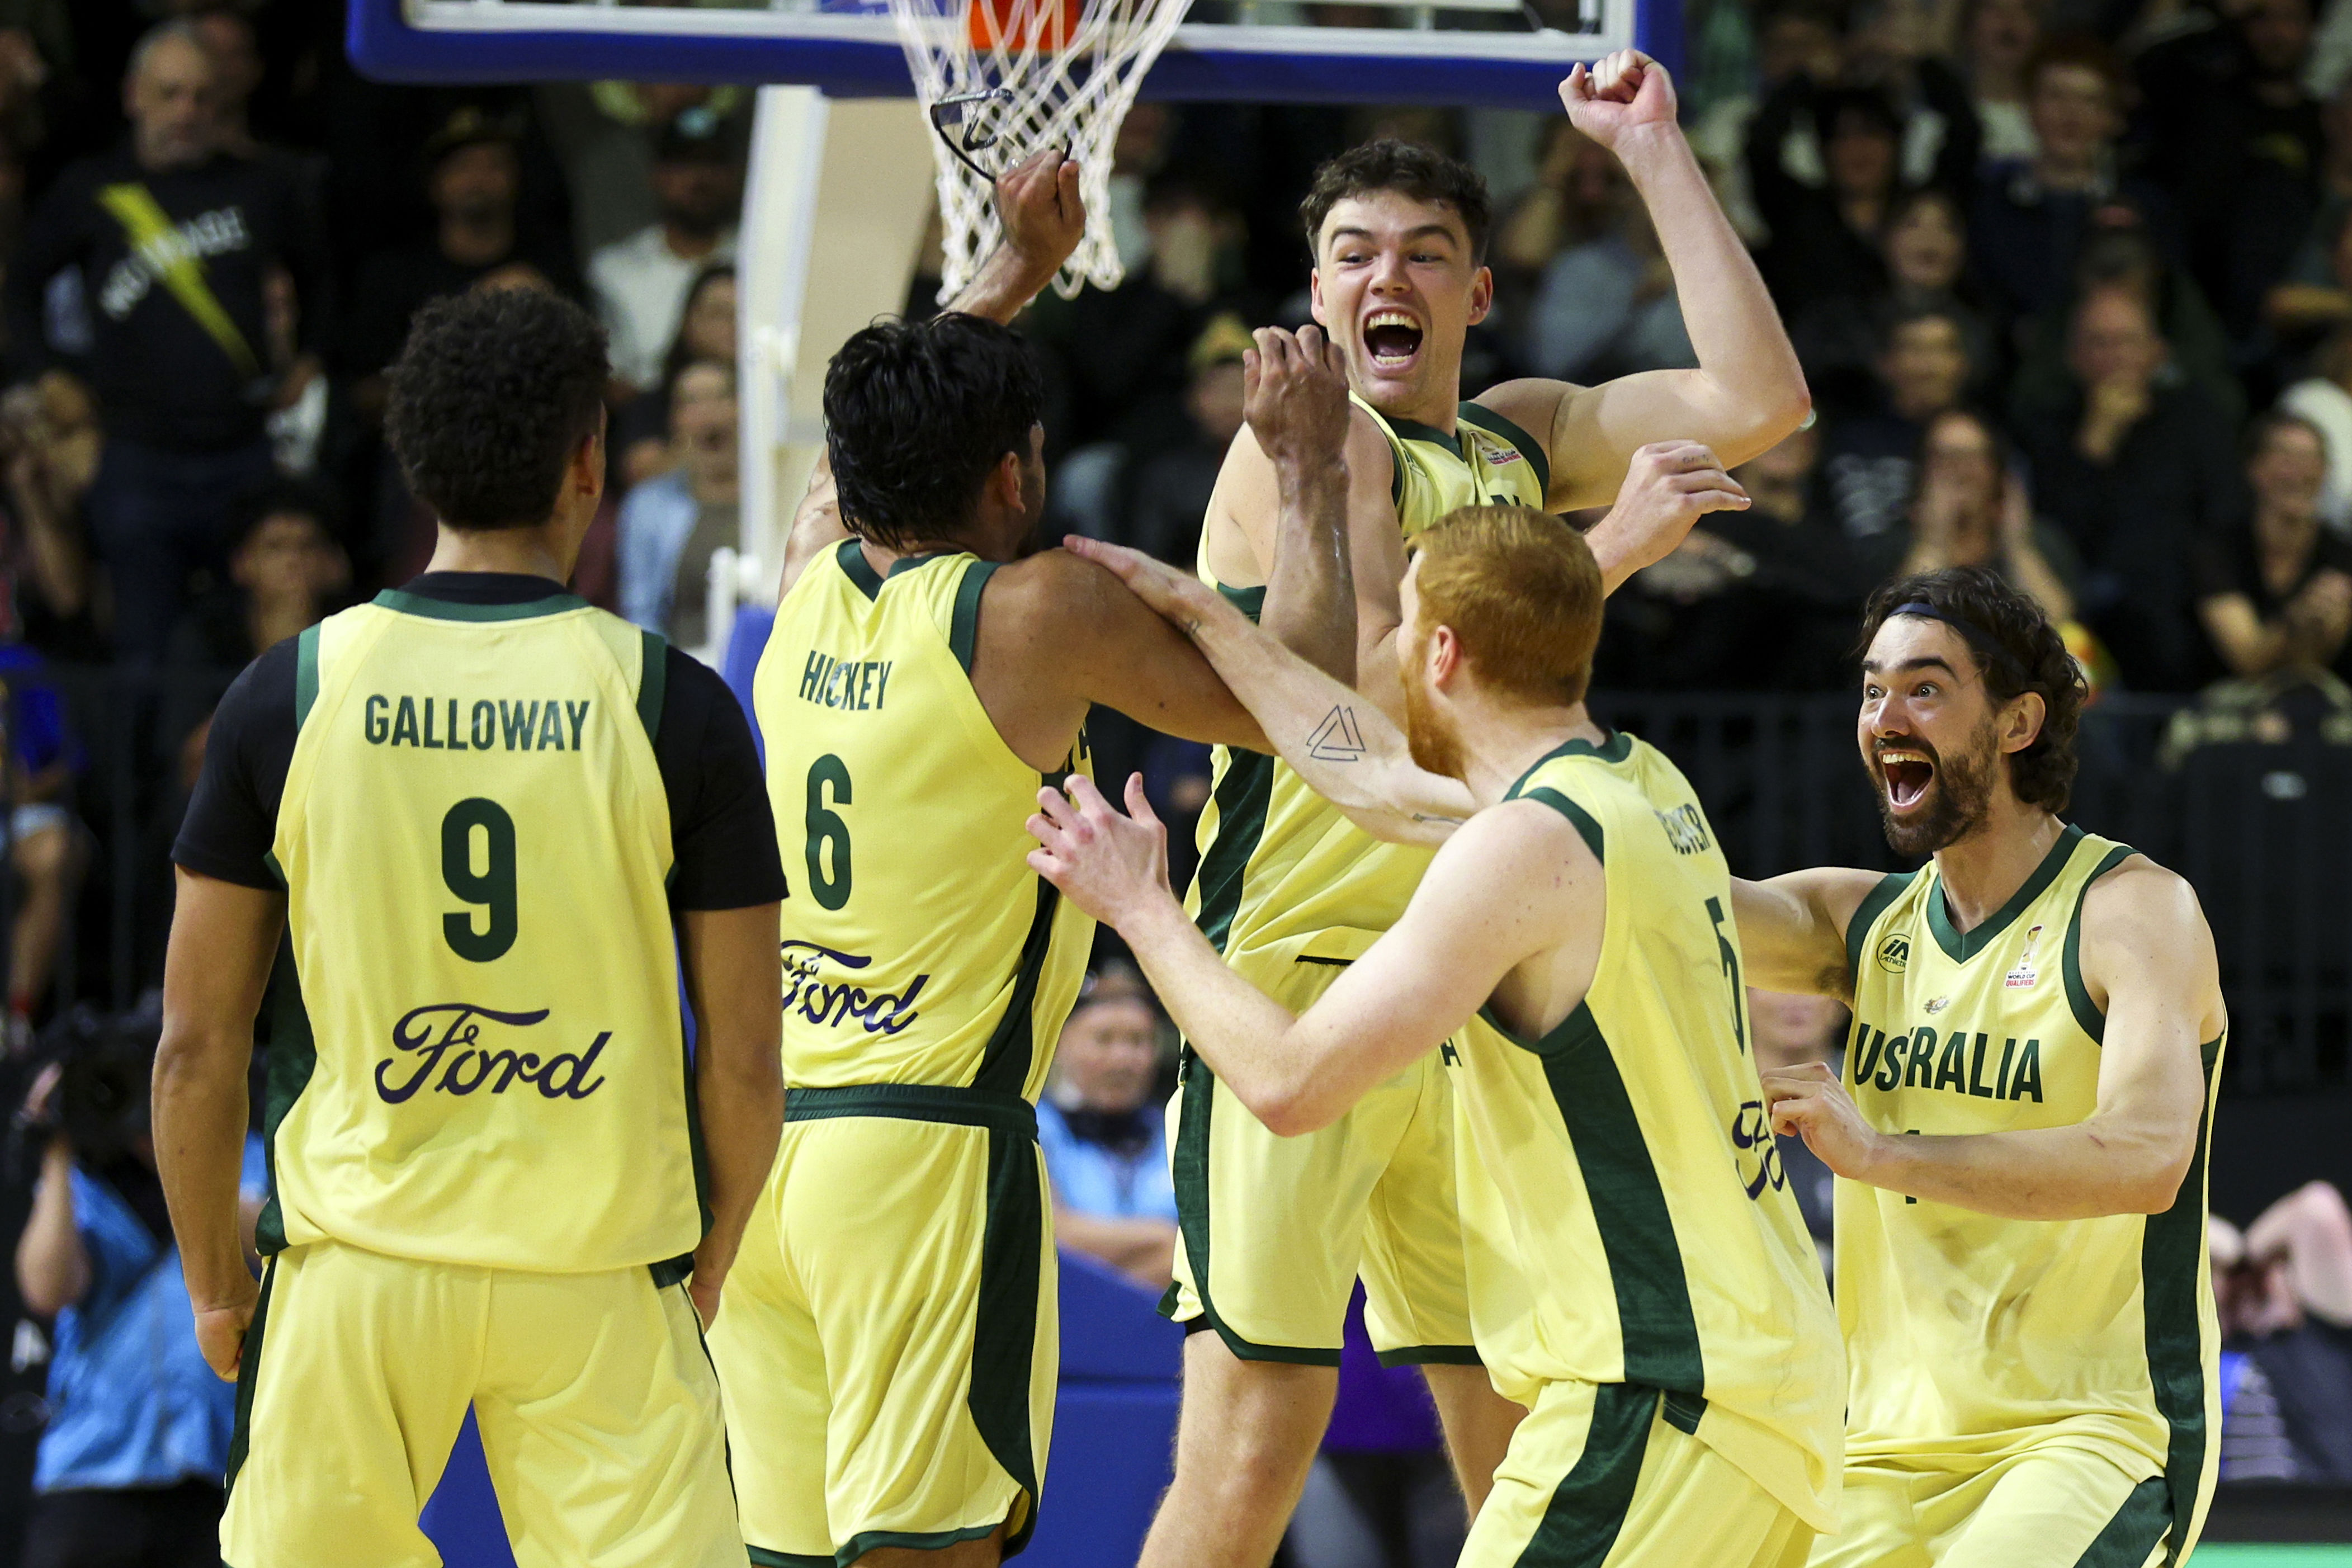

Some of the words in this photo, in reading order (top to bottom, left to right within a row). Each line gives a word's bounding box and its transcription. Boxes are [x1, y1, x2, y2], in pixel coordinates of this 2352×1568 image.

[365, 694, 590, 751] GALLOWAY
[799, 650, 891, 711] HICKEY
[441, 797, 518, 962] 9
[805, 753, 852, 911] 6
[782, 940, 929, 1035] Ford
[1704, 896, 1744, 1056] 5
[375, 1003, 613, 1104] Ford
[1854, 1023, 2043, 1103] USRALIA
